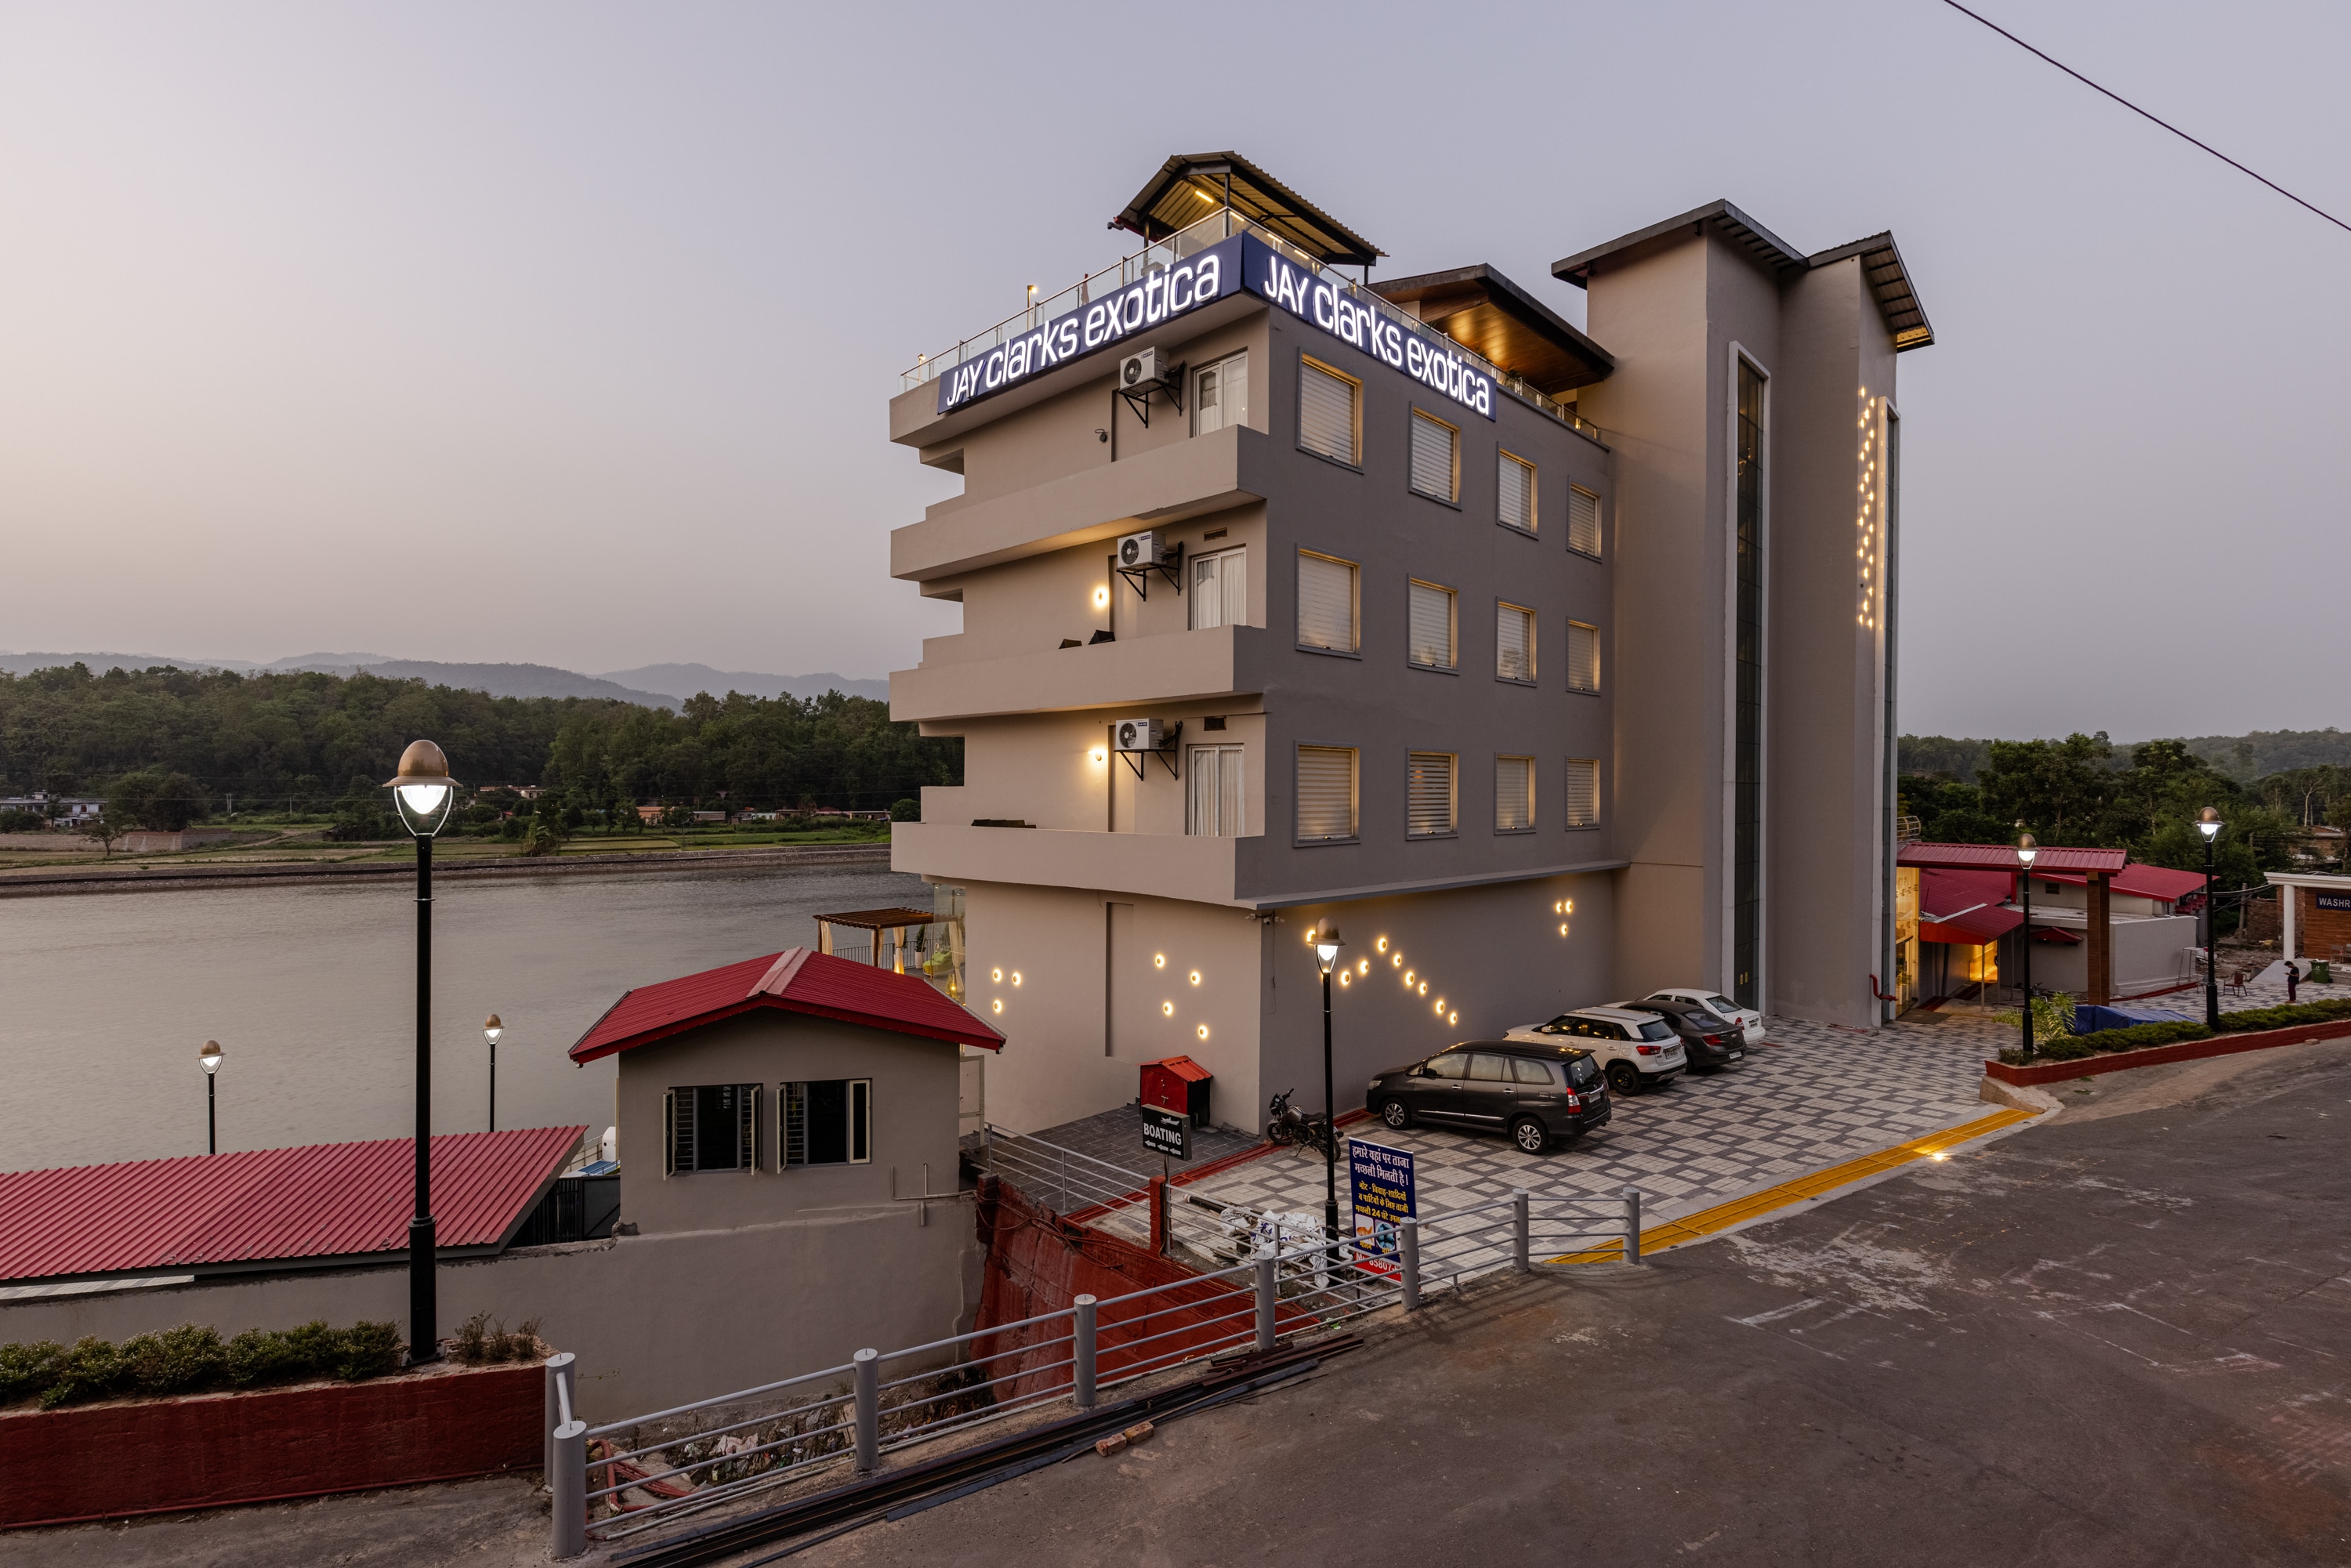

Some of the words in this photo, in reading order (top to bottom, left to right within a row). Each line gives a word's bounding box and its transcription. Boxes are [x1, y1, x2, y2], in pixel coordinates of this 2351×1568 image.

[947, 359, 985, 406] JAY
[986, 317, 1079, 389] clarks
[1085, 254, 1220, 348] exotica
[1264, 255, 1309, 314] JAY
[1313, 283, 1402, 367] clarks
[1407, 337, 1489, 415] exotica
[1143, 1122, 1182, 1146] BOATING
[1352, 1145, 1368, 1159] हमारे
[1369, 1148, 1382, 1164] यहां
[1382, 1153, 1392, 1164] पर
[1392, 1155, 1410, 1168] ताजा
[1354, 1163, 1376, 1177] मच्छली
[1376, 1164, 1399, 1183] मिलती
[1371, 1208, 1381, 1218] 24
[1379, 1197, 1386, 1207] के
